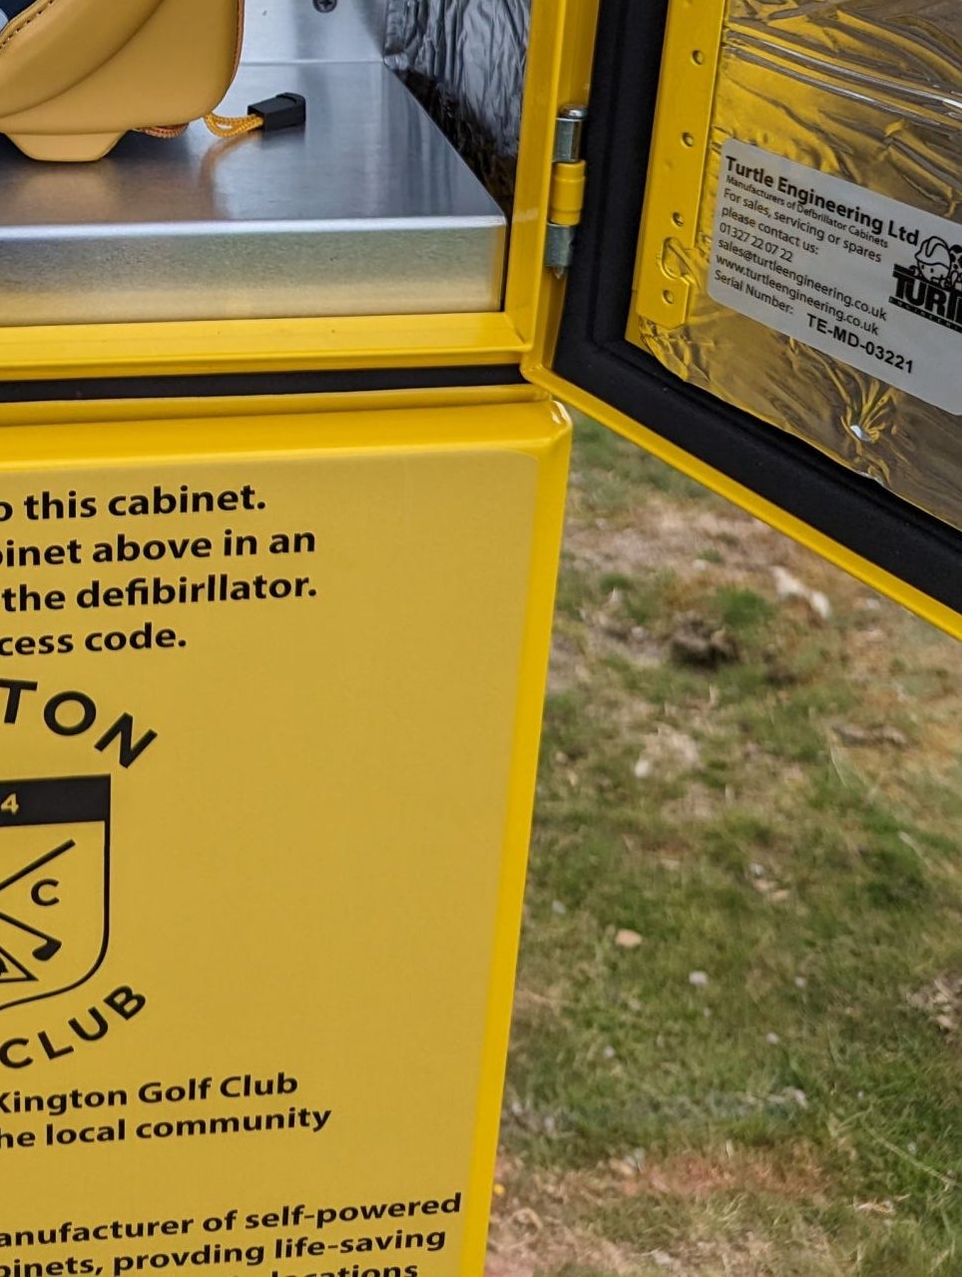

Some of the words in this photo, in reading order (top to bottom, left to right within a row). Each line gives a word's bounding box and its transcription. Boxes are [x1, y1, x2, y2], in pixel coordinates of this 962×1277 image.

[725, 155, 775, 188] Turtle
[777, 176, 884, 235] Engineering
[888, 220, 920, 247] Ltd
[725, 175, 785, 208] Manufacturers
[786, 200, 797, 211] of
[848, 225, 889, 249] Cabinets
[721, 205, 757, 229] please
[758, 221, 801, 248] contact
[802, 241, 819, 255] us:
[723, 187, 742, 204] For
[742, 196, 773, 218] sales,
[774, 209, 825, 243] servicing
[827, 232, 842, 246] or
[842, 239, 883, 264] spares
[714, 270, 744, 292] Serial
[746, 283, 795, 315] Number:
[716, 254, 880, 336] www.turtleengineering.co.uk
[718, 238, 888, 322] sales@turtleengineering.co.uk
[806, 312, 914, 374] TE-MD-03221
[23, 490, 97, 521] this
[108, 484, 266, 517] cabinet.
[92, 533, 212, 563] above
[223, 528, 258, 557] in
[268, 532, 315, 555] an
[1, 583, 66, 613] the
[84, 621, 187, 652] code.
[30, 878, 60, 907] C
[138, 1076, 213, 1104] Golf
[219, 1072, 298, 1098] Club
[46, 1118, 126, 1146] local
[135, 1106, 332, 1139] community
[202, 1209, 238, 1233] of
[245, 1192, 462, 1235] self-powered
[113, 1243, 265, 1277] provding
[275, 1229, 446, 1259] life-saving
